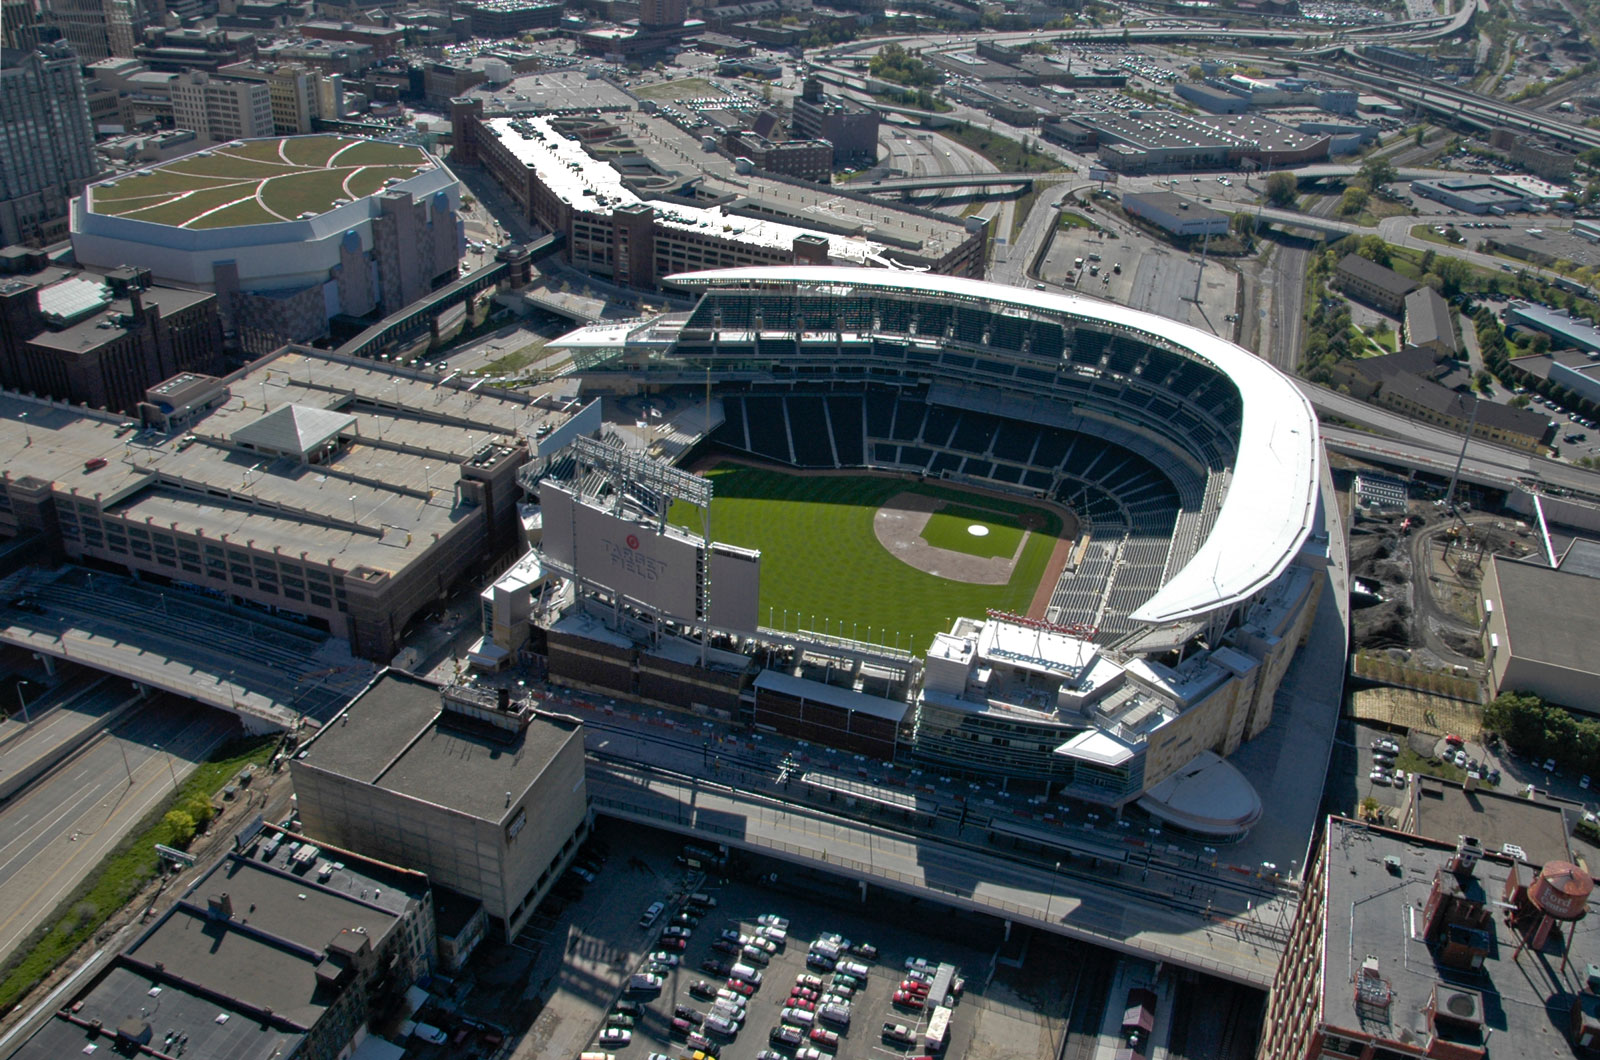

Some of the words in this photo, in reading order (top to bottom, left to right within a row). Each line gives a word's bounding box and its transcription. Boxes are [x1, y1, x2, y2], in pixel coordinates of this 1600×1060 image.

[600, 538, 668, 574] TARGET
[610, 553, 658, 581] FIELD
[1544, 887, 1572, 907] Ford
